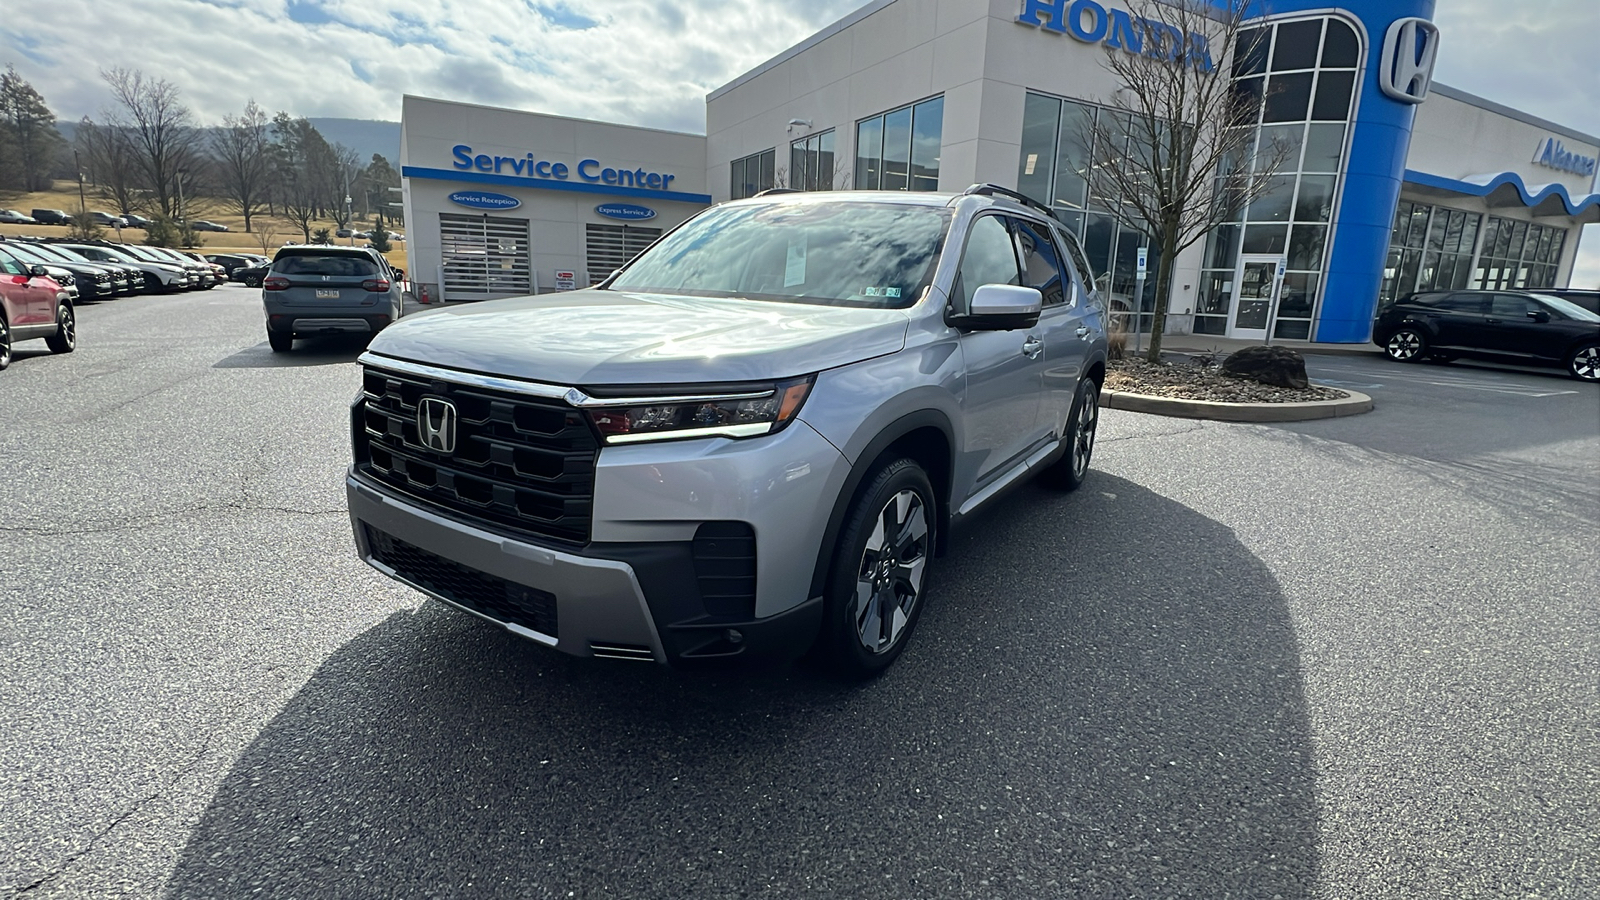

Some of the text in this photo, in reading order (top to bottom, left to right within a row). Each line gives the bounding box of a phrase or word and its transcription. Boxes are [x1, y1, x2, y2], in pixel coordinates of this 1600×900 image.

[1017, 0, 1215, 72] HONDA
[452, 144, 675, 190] Service Center
[453, 194, 517, 206] Service Reception
[598, 206, 644, 217] Express Service
